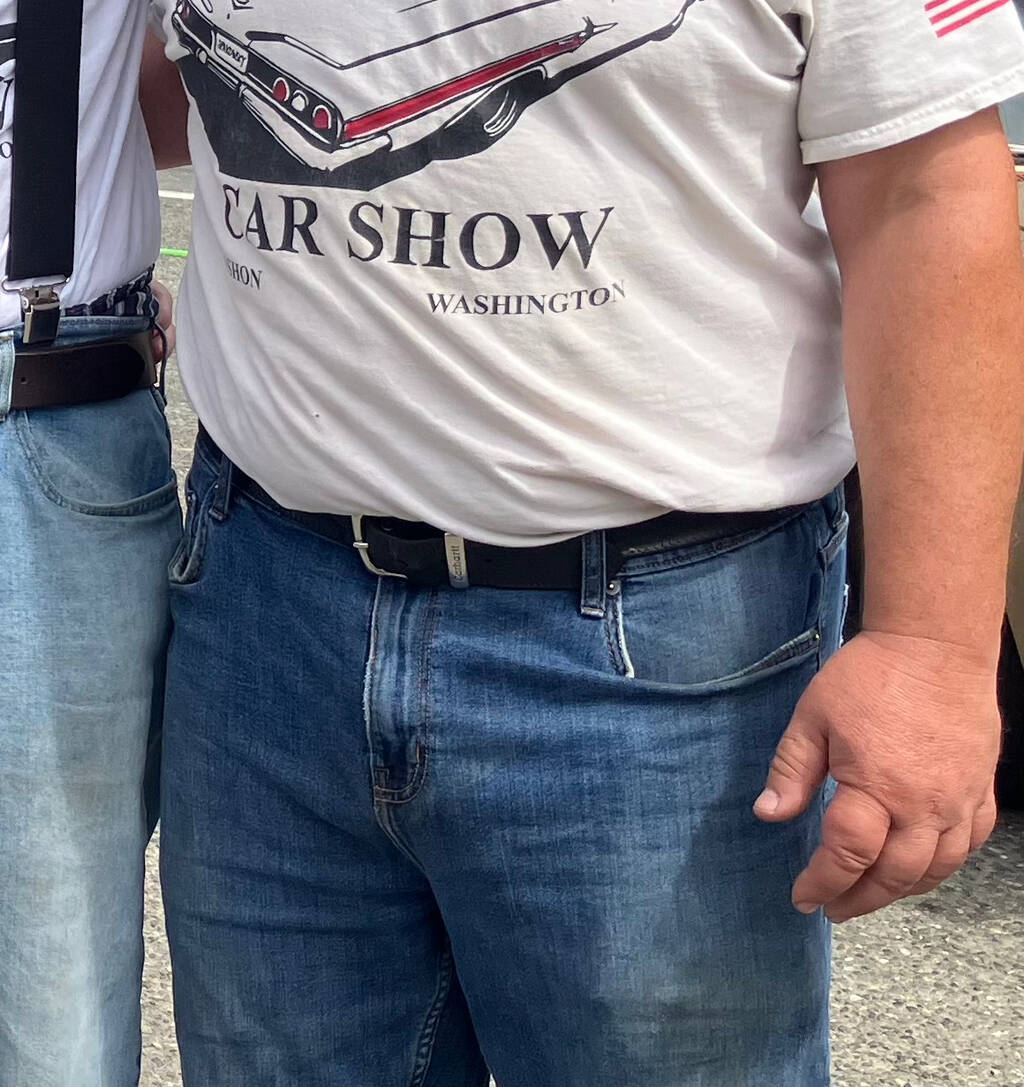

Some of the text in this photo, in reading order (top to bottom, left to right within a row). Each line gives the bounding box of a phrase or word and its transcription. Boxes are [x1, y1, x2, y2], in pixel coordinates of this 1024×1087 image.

[221, 183, 615, 271] CAR SHOW
[427, 279, 626, 315] WASHINGTON
